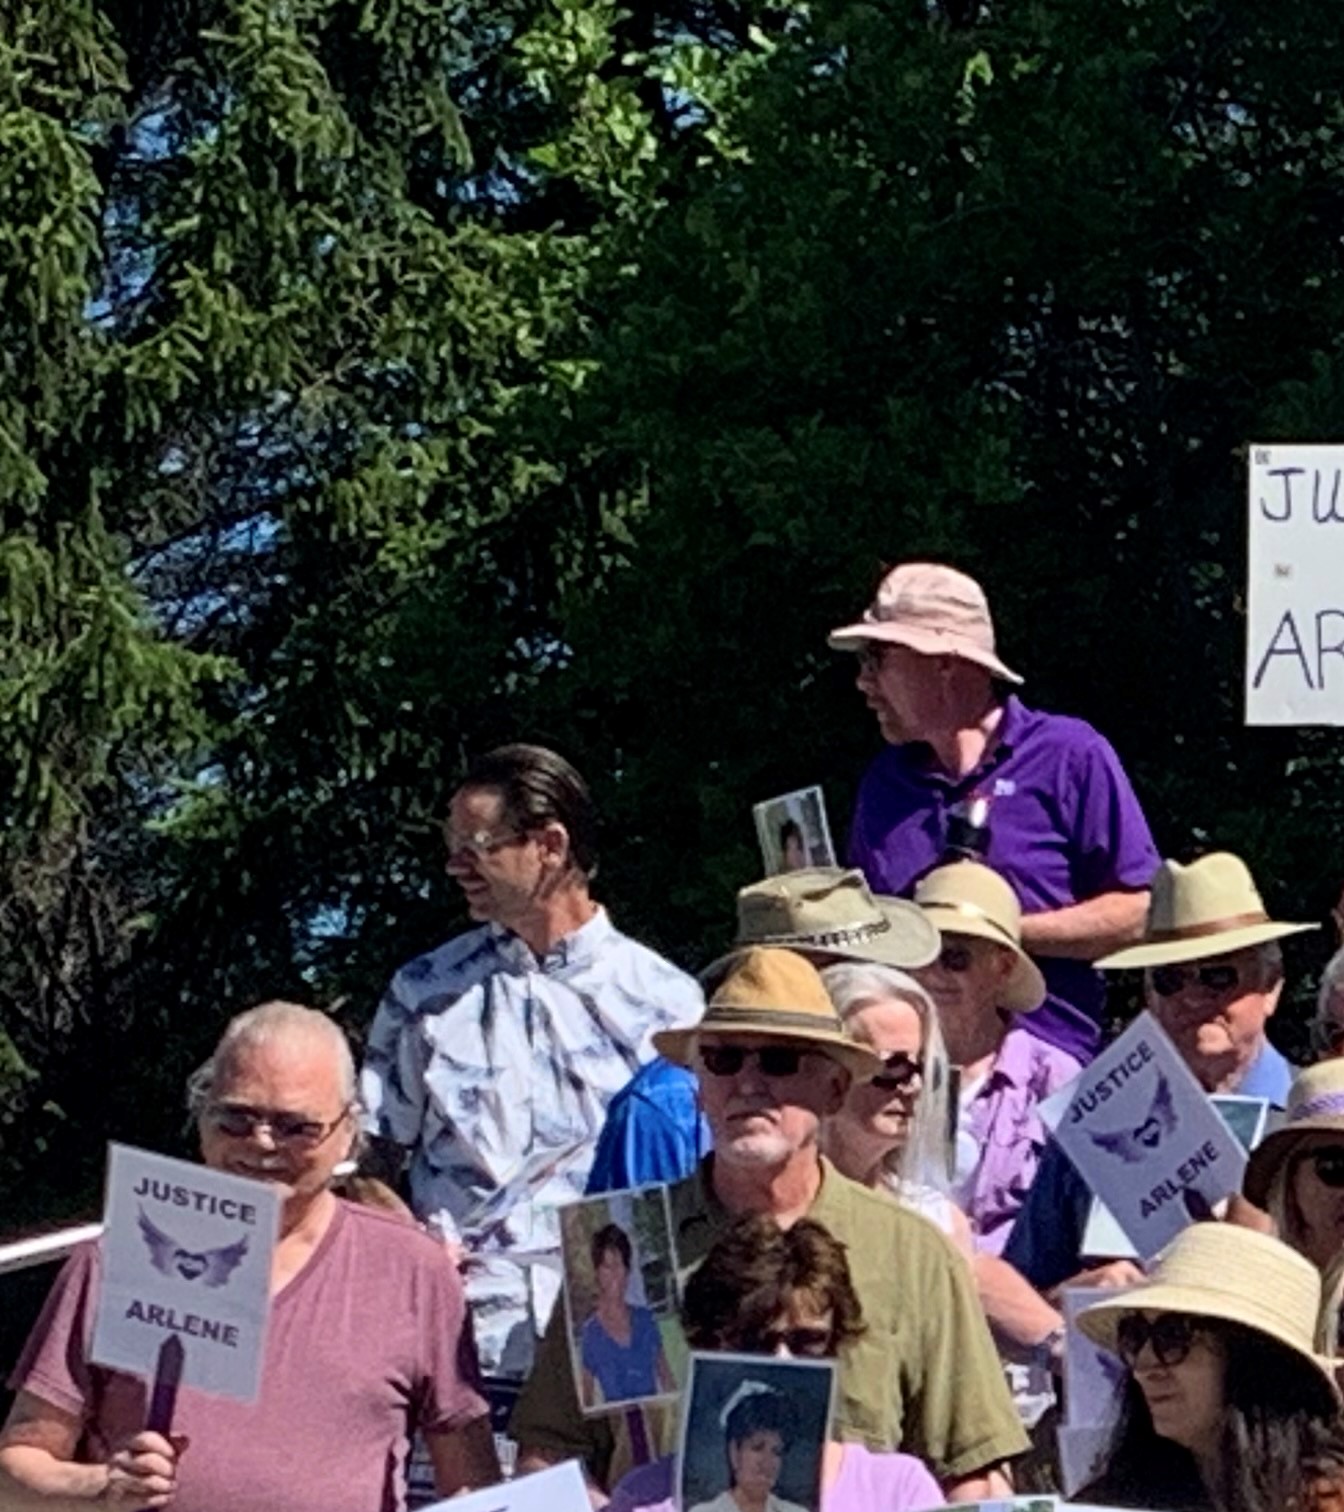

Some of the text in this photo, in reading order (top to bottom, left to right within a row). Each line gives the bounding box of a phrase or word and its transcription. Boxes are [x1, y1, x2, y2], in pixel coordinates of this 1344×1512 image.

[1070, 1040, 1155, 1124] JUSTICE
[134, 1177, 257, 1225] JUSTICE
[1139, 1140, 1219, 1219] ARLENE
[125, 1300, 240, 1348] ARLENE
